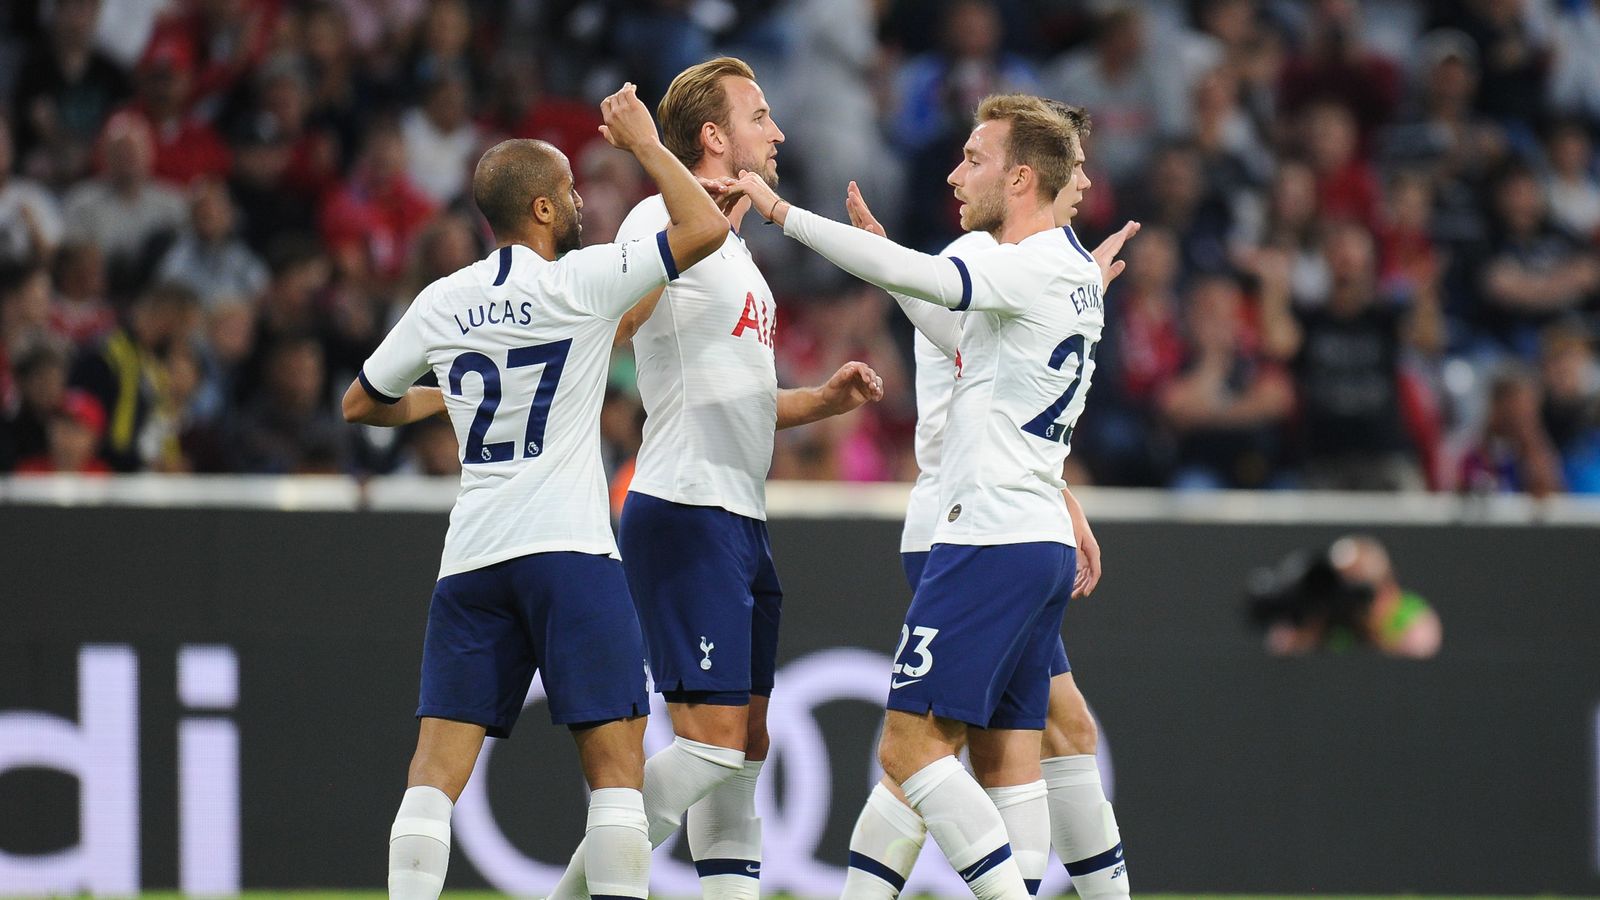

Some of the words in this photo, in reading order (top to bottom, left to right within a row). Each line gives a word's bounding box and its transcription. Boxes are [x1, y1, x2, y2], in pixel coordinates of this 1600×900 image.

[454, 300, 532, 335] LUCAS
[1069, 284, 1103, 316] ERIK
[449, 338, 573, 464] 27
